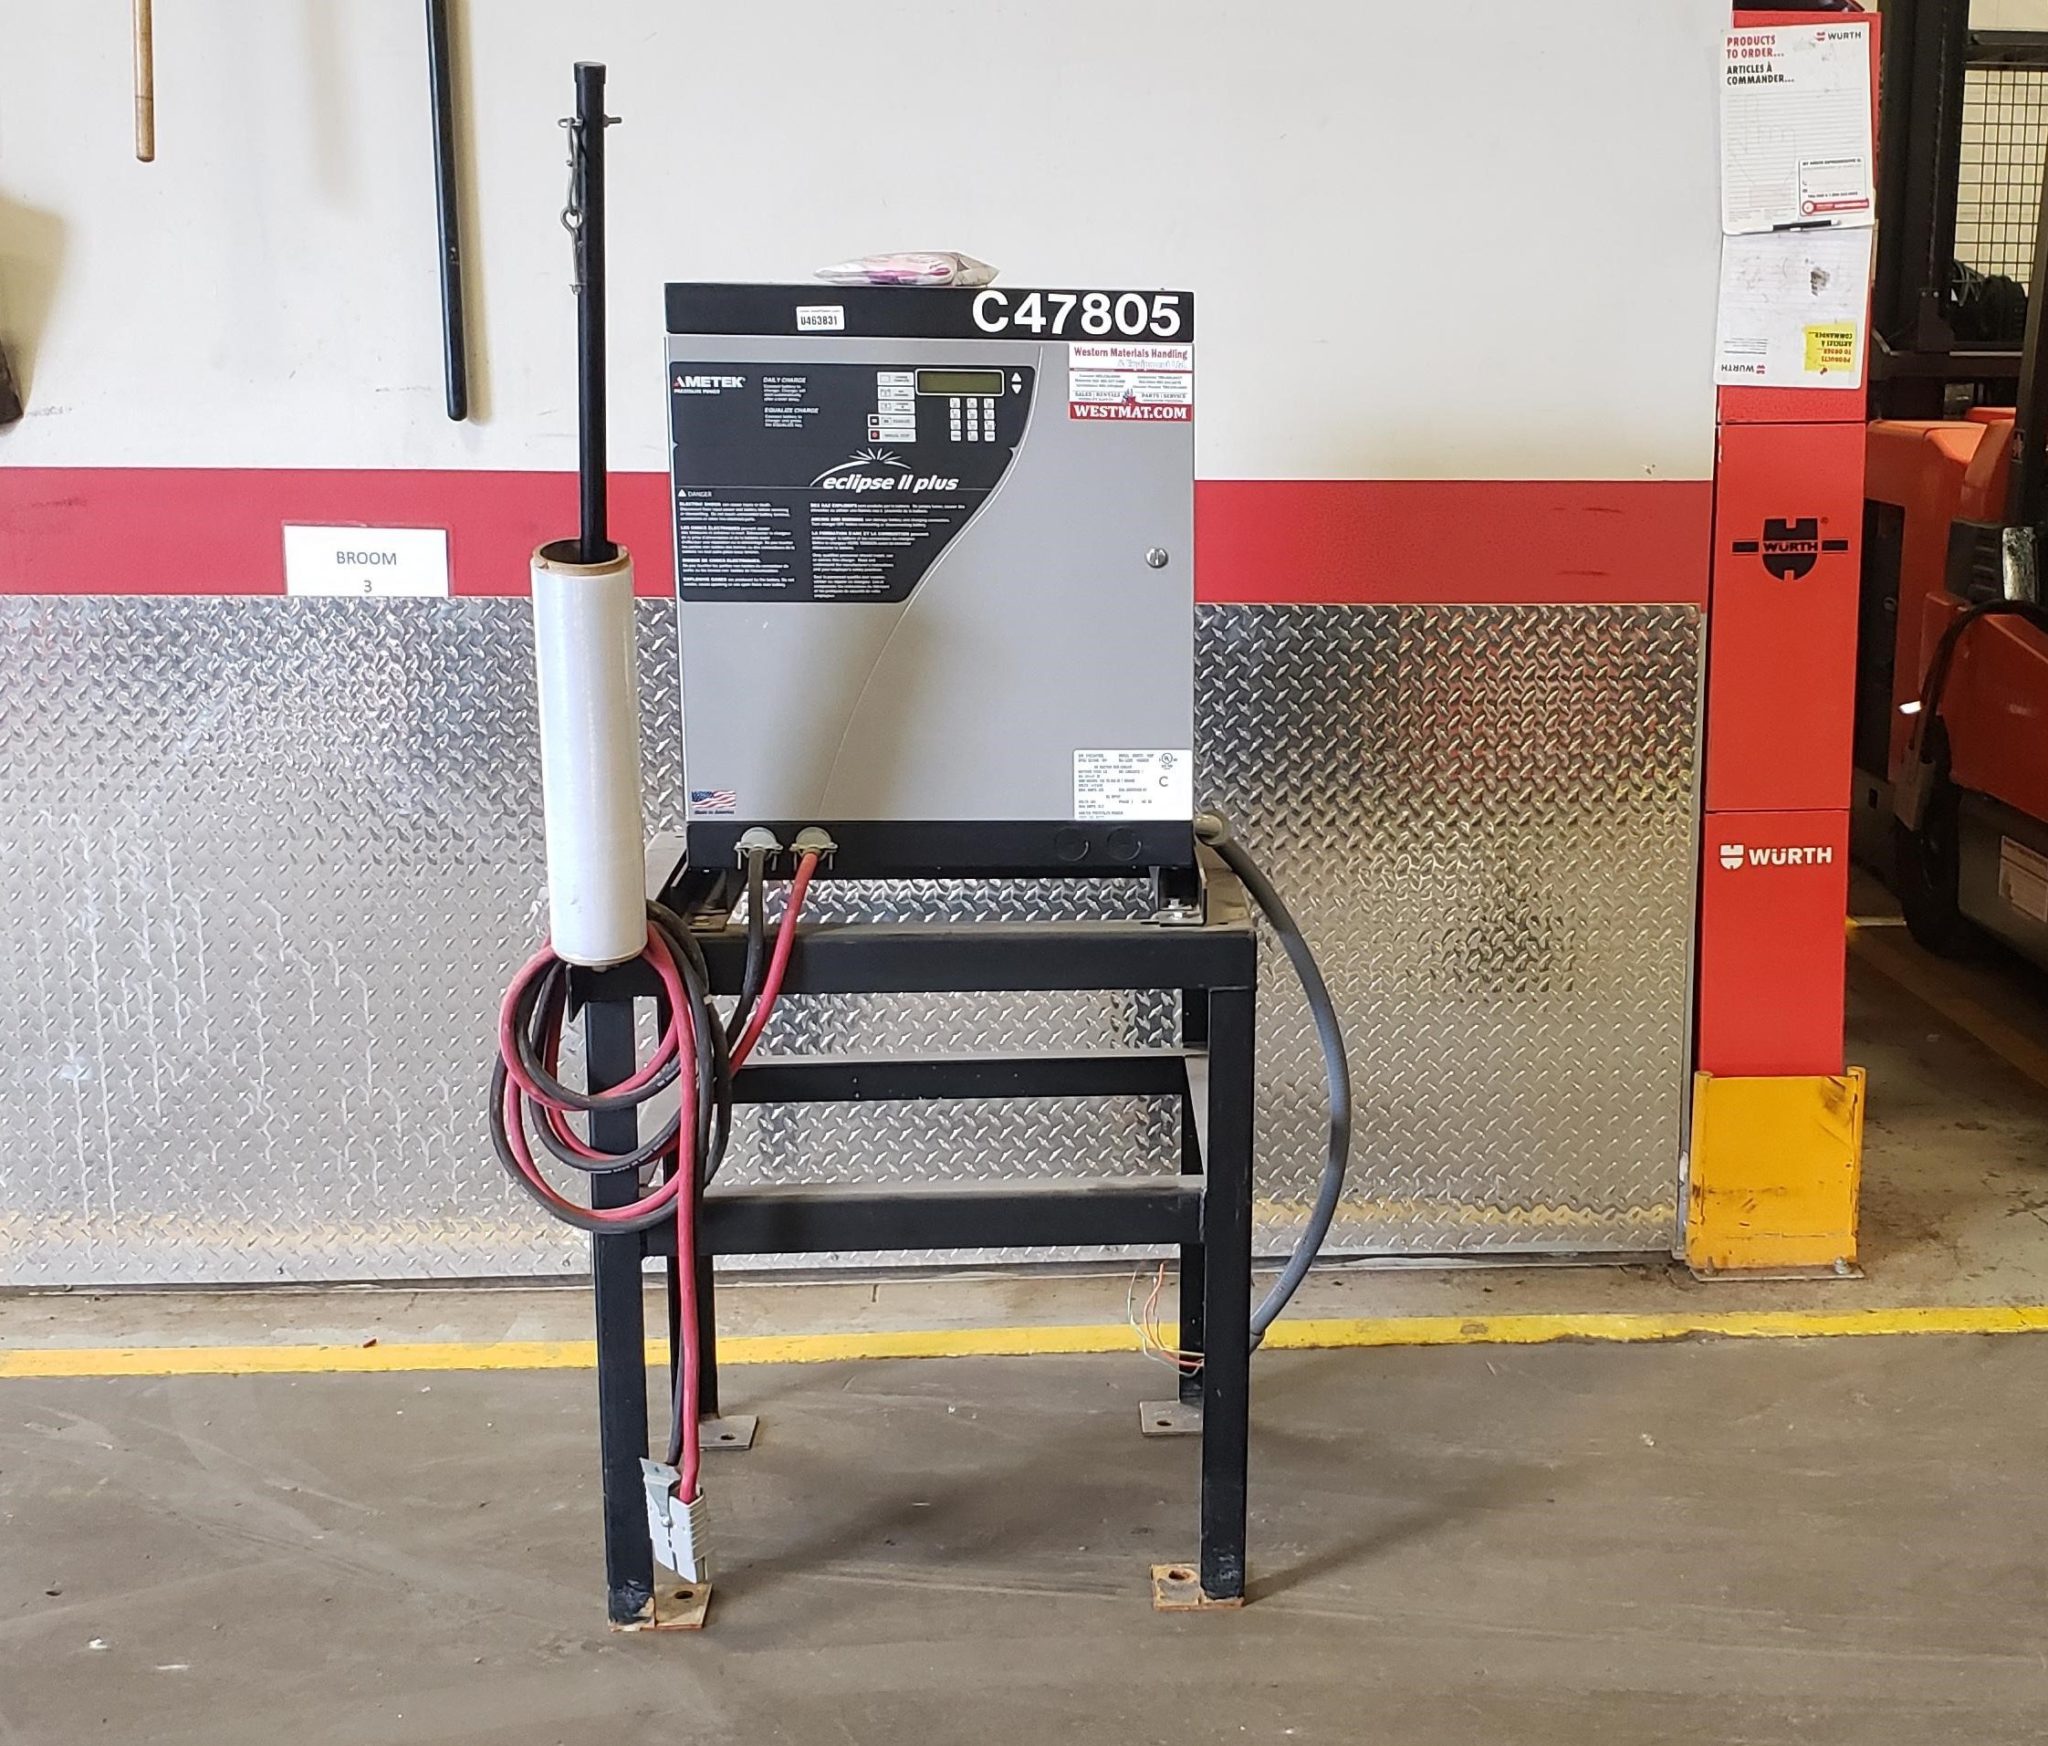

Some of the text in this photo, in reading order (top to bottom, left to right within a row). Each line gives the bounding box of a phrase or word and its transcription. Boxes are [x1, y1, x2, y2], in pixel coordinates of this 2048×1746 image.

[1726, 35, 1776, 47] PRODUCTS
[1726, 48, 1784, 59] TO ORDER...
[1726, 61, 1773, 74] ARTICLES À
[1726, 74, 1795, 85] COMMANDER...
[972, 289, 1182, 337] C47805
[1074, 346, 1188, 360] Western Materials Handling
[673, 376, 743, 388] AMETEK
[1073, 404, 1188, 419] WESTMAT.COM
[822, 474, 960, 493] eclipse II plus
[336, 551, 397, 566] BROOM
[363, 579, 373, 593] 3
[1748, 846, 1832, 866] WÜRTH
